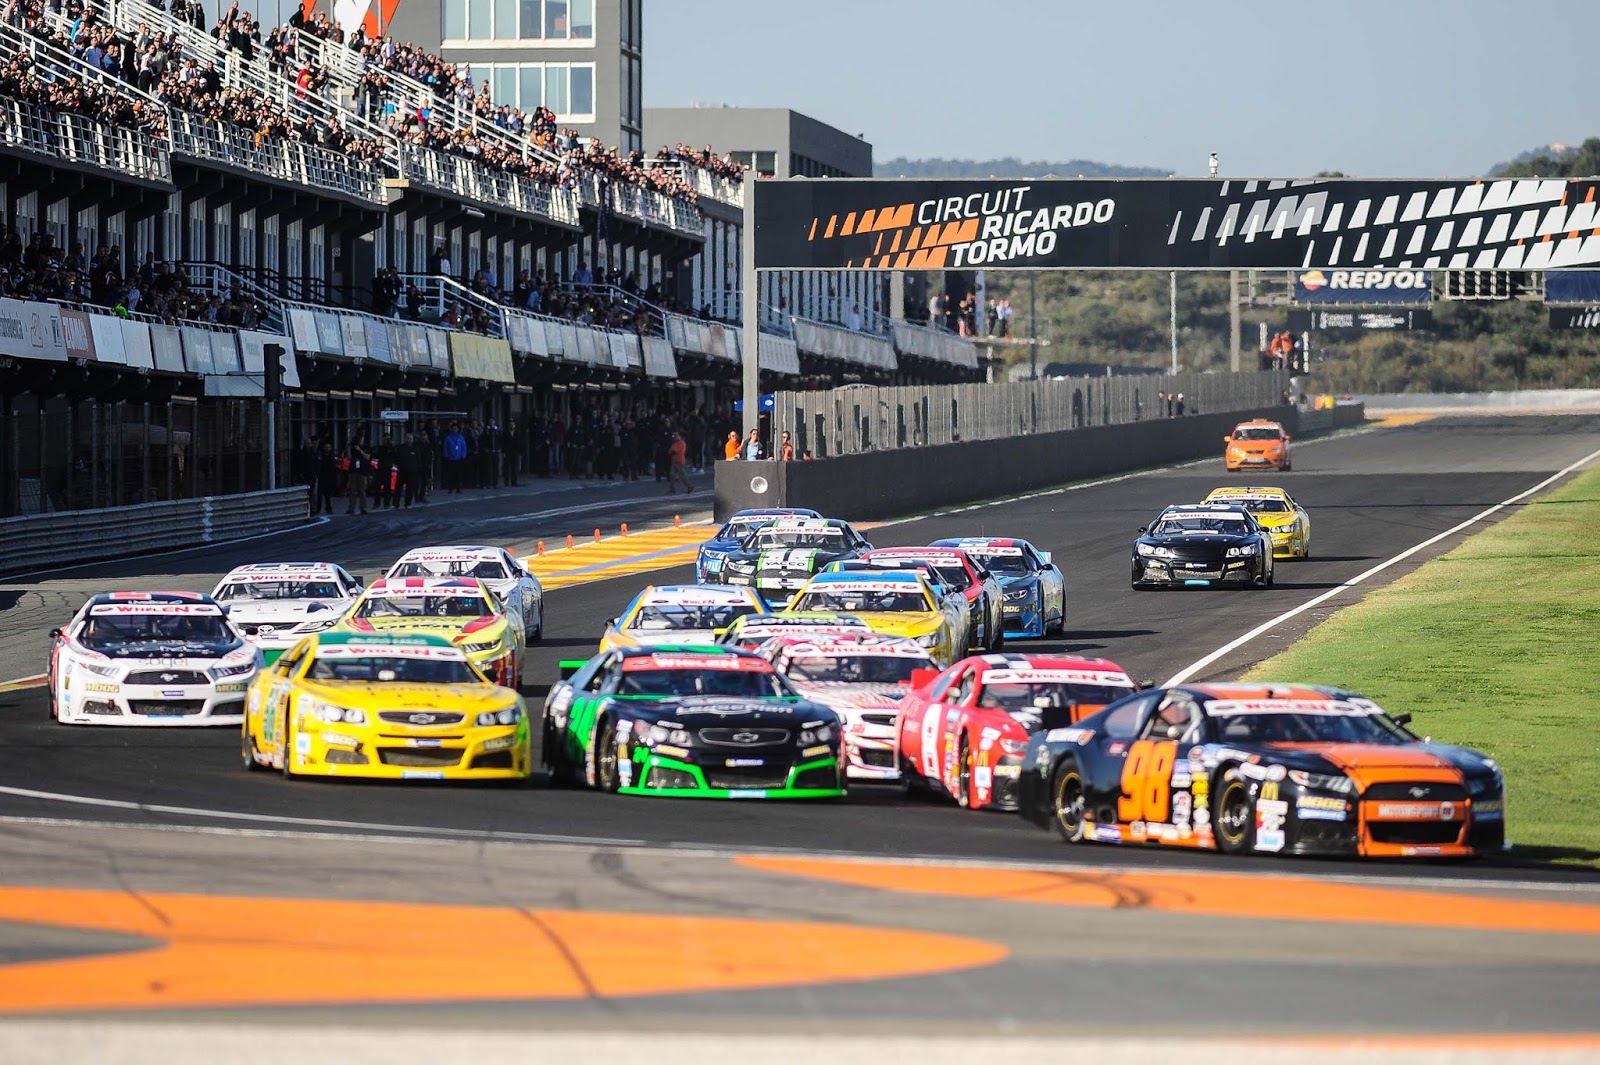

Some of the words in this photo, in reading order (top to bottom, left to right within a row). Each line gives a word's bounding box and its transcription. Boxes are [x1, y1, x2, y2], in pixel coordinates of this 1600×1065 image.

[917, 186, 1030, 225] CIRCUIT
[981, 198, 1115, 239] RICARDO
[951, 231, 1057, 267] TORMO
[1329, 271, 1427, 289] REPSOL
[349, 647, 430, 656] WHELEN
[818, 645, 895, 653] WHELEN
[652, 658, 740, 668] WHELEN
[1016, 672, 1098, 681] WHELEN
[1118, 740, 1178, 822] 98
